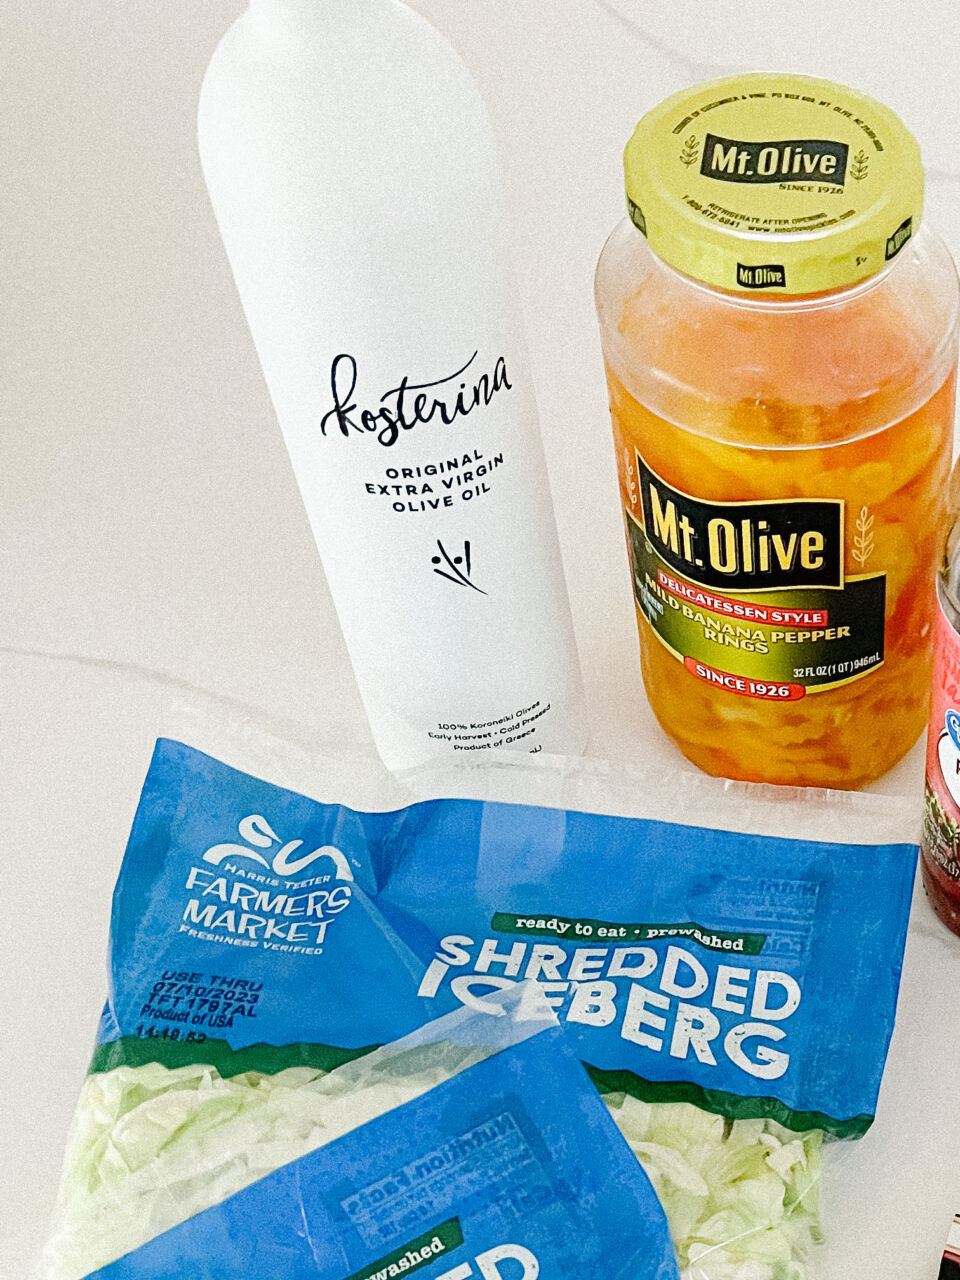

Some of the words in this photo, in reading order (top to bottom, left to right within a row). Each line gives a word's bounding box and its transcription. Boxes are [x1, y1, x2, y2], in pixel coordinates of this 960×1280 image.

[779, 183, 814, 193] SINCE
[817, 186, 844, 195] 1926
[365, 482, 434, 496] EXTRA
[441, 452, 504, 490] VIRGIN
[385, 449, 484, 480] ORIGINAL
[392, 495, 454, 513] OLIVE
[461, 483, 491, 502] OIL
[645, 572, 680, 611] MILD
[682, 605, 767, 643] BANANA
[770, 625, 852, 644] PEPPER
[659, 573, 768, 621] DELICATESSEN
[771, 612, 823, 624] STYLE
[703, 628, 770, 655] RINGS
[695, 664, 746, 692] SINCE
[749, 682, 790, 698] 1926
[793, 668, 805, 678] 32
[428, 732, 452, 741] Early
[454, 732, 492, 741] Harvest
[500, 722, 520, 735] Cold
[522, 703, 551, 726] Pressed
[438, 723, 468, 731] 100%
[470, 713, 514, 729] Koroneiki
[516, 701, 540, 717] Olives
[454, 743, 492, 751] Product
[493, 739, 503, 747] of
[505, 727, 536, 744] Greece
[186, 866, 352, 917] FARMERS
[224, 862, 279, 887] HARRIS
[284, 874, 331, 890] TEETER
[182, 899, 335, 945] MARKET
[516, 914, 571, 935] ready
[575, 922, 593, 937] to
[597, 925, 627, 938] eat
[647, 925, 745, 951] prewashed
[178, 924, 258, 949] FRESHNESS
[262, 941, 323, 955] VERIFIED
[152, 982, 260, 1004] 07/10/2023
[161, 970, 203, 983] USE
[209, 975, 263, 992] THRU
[434, 934, 802, 1022] SHREDDED
[140, 1004, 189, 1023] Product
[191, 1013, 207, 1024] of
[208, 1014, 234, 1028] USA
[147, 993, 184, 1007] TFT
[188, 998, 257, 1018] 1797AL
[417, 957, 792, 1081] ICEBERG
